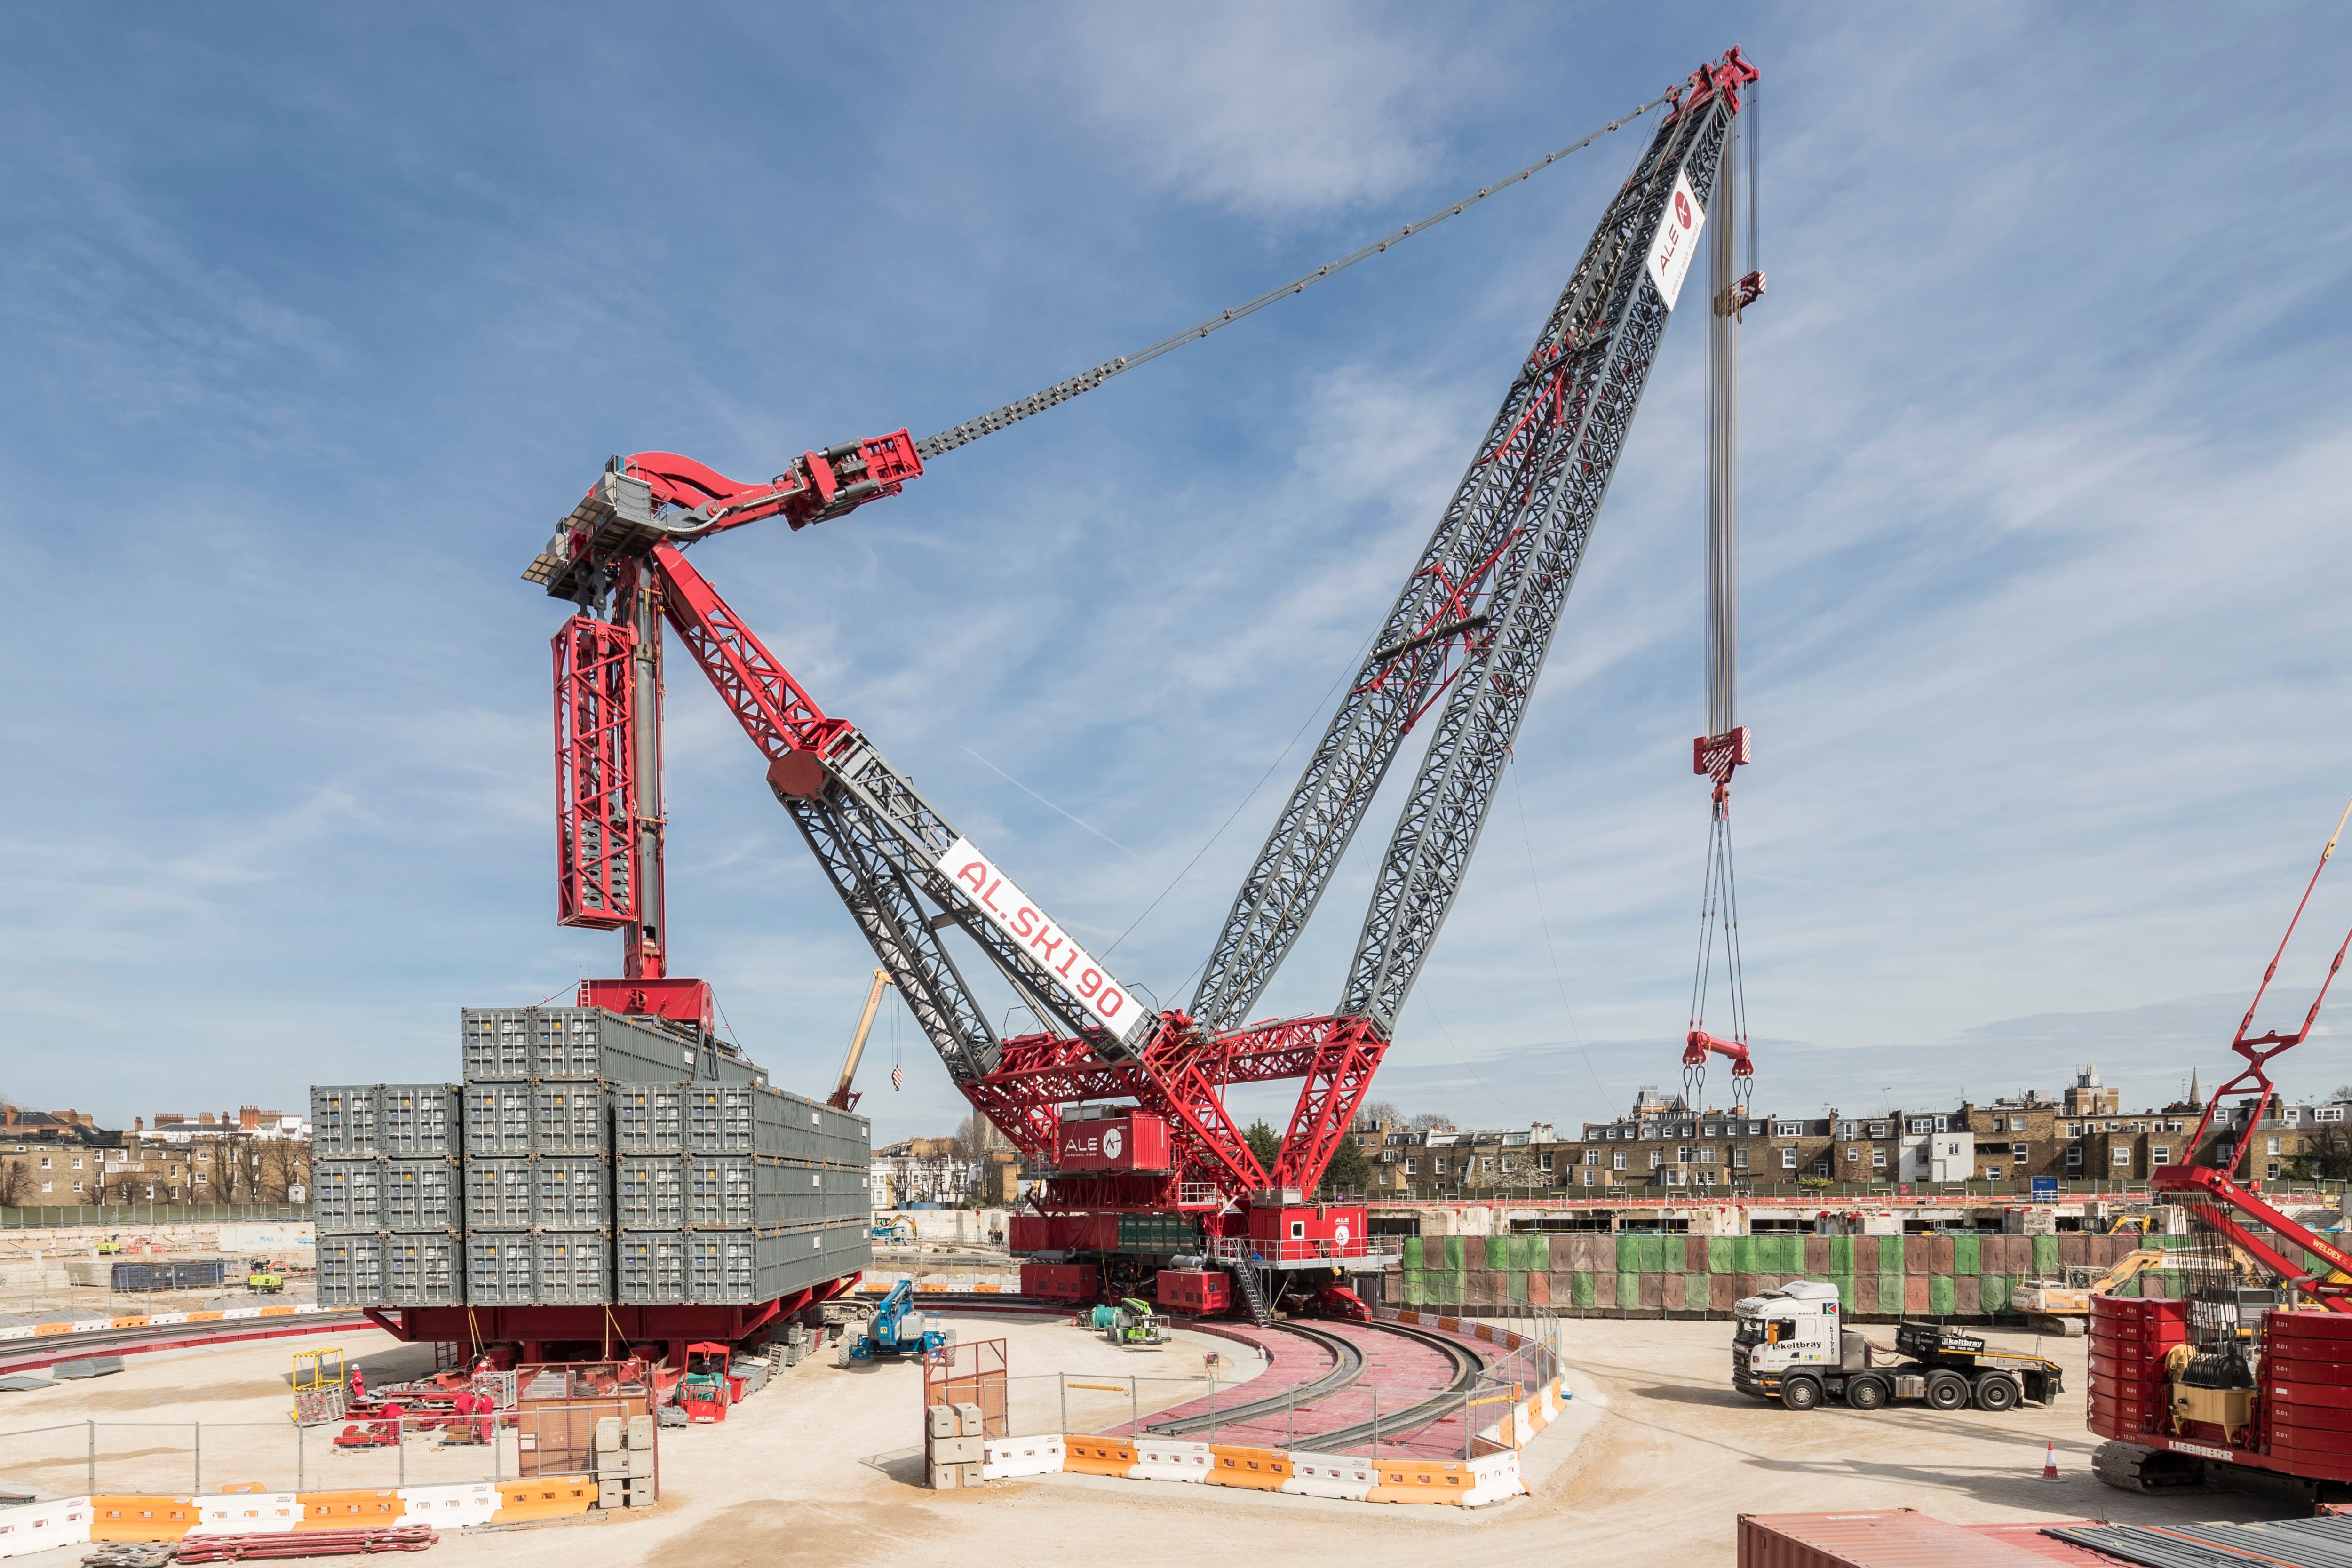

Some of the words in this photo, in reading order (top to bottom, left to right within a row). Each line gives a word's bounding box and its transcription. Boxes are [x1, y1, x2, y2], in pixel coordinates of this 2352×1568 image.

[1661, 223, 1679, 276] ALE
[957, 861, 1123, 1018] AL.SK190
[1065, 1138, 1097, 1152] ALE
[2313, 1239, 2342, 1261] WELDEX
[1781, 1341, 1821, 1350] keltbray
[1948, 1338, 1982, 1348] keltbray
[2169, 1441, 2233, 1461] LIEBHERR
